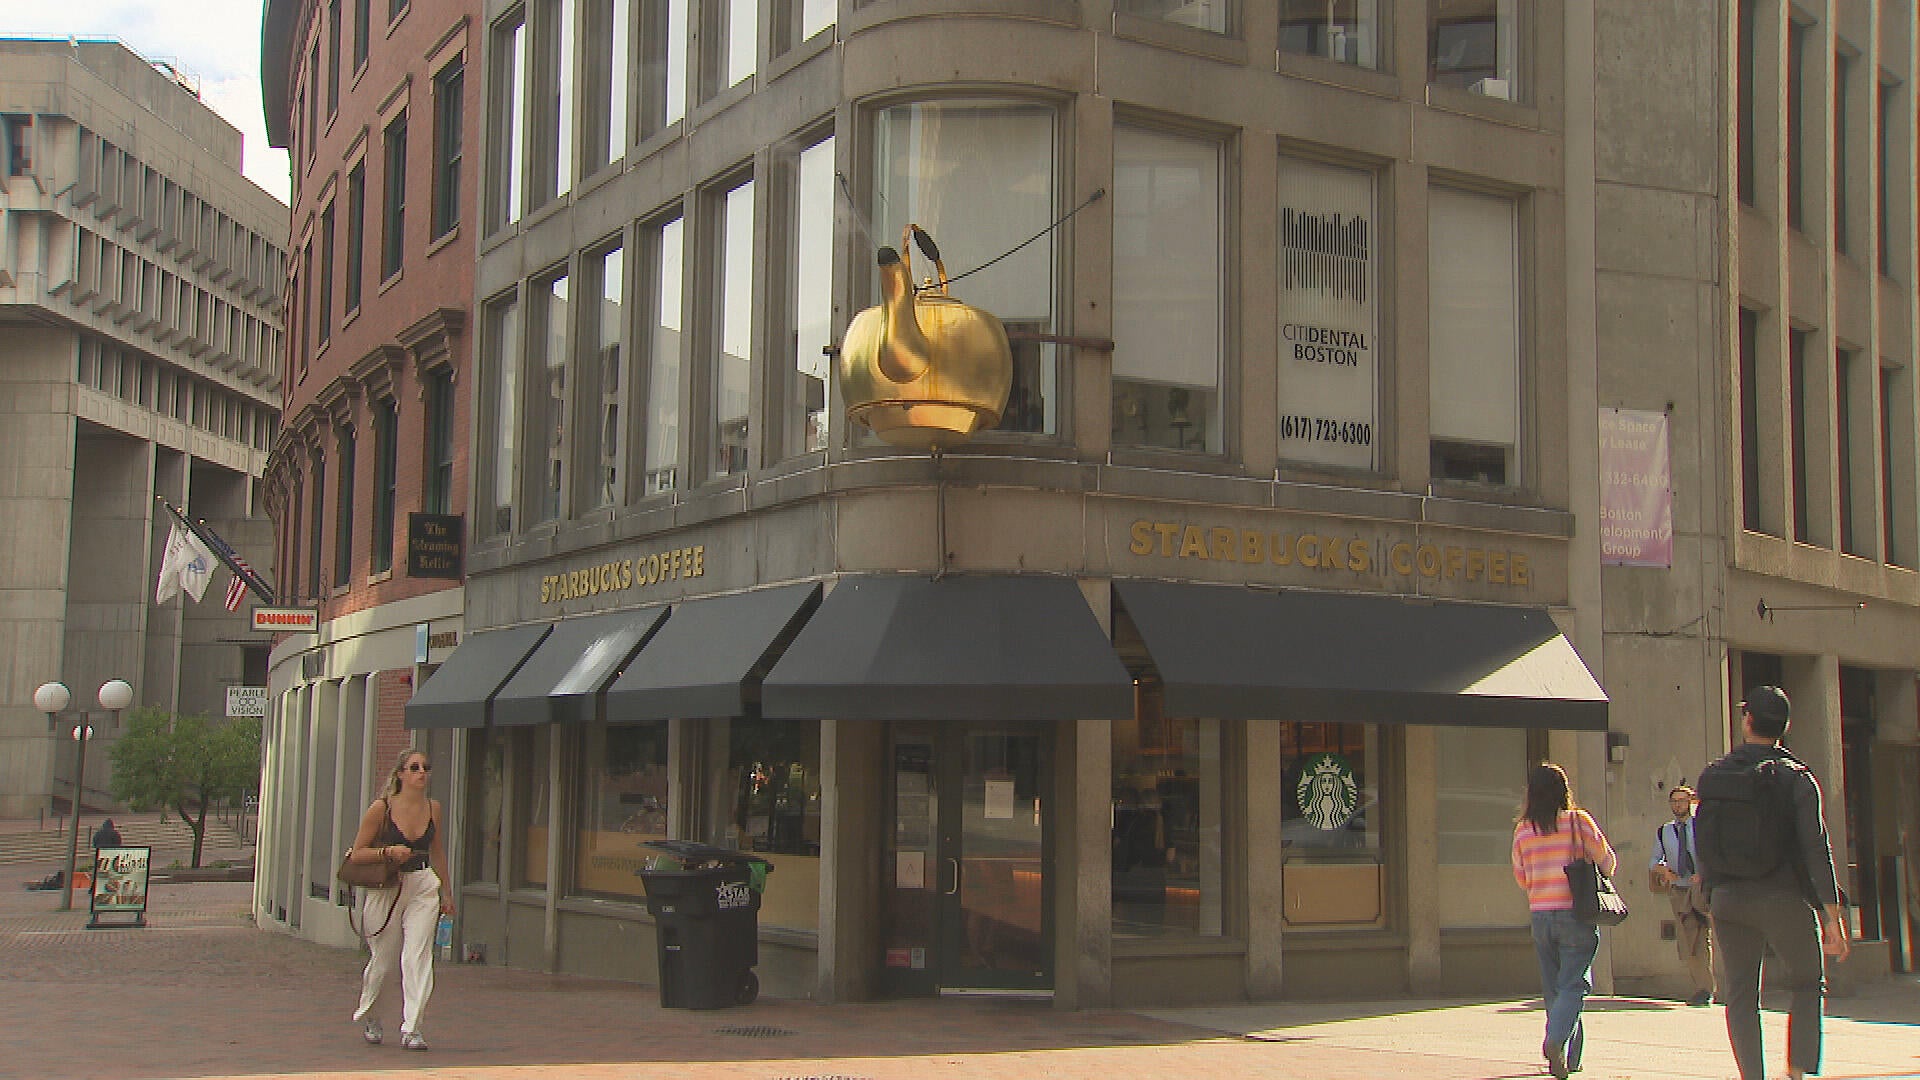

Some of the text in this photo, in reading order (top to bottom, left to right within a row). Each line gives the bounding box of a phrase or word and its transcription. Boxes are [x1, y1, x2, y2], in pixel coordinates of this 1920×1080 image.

[1282, 323, 1369, 351] CITIDENTAL
[1294, 343, 1358, 367] BOSTON
[1281, 415, 1312, 443] (617)
[1129, 521, 1530, 586] STARBUCKS COFFEE
[1602, 541, 1642, 559] Group
[541, 545, 704, 604] STARBUCKS COFFEE
[231, 705, 264, 715] VISION
